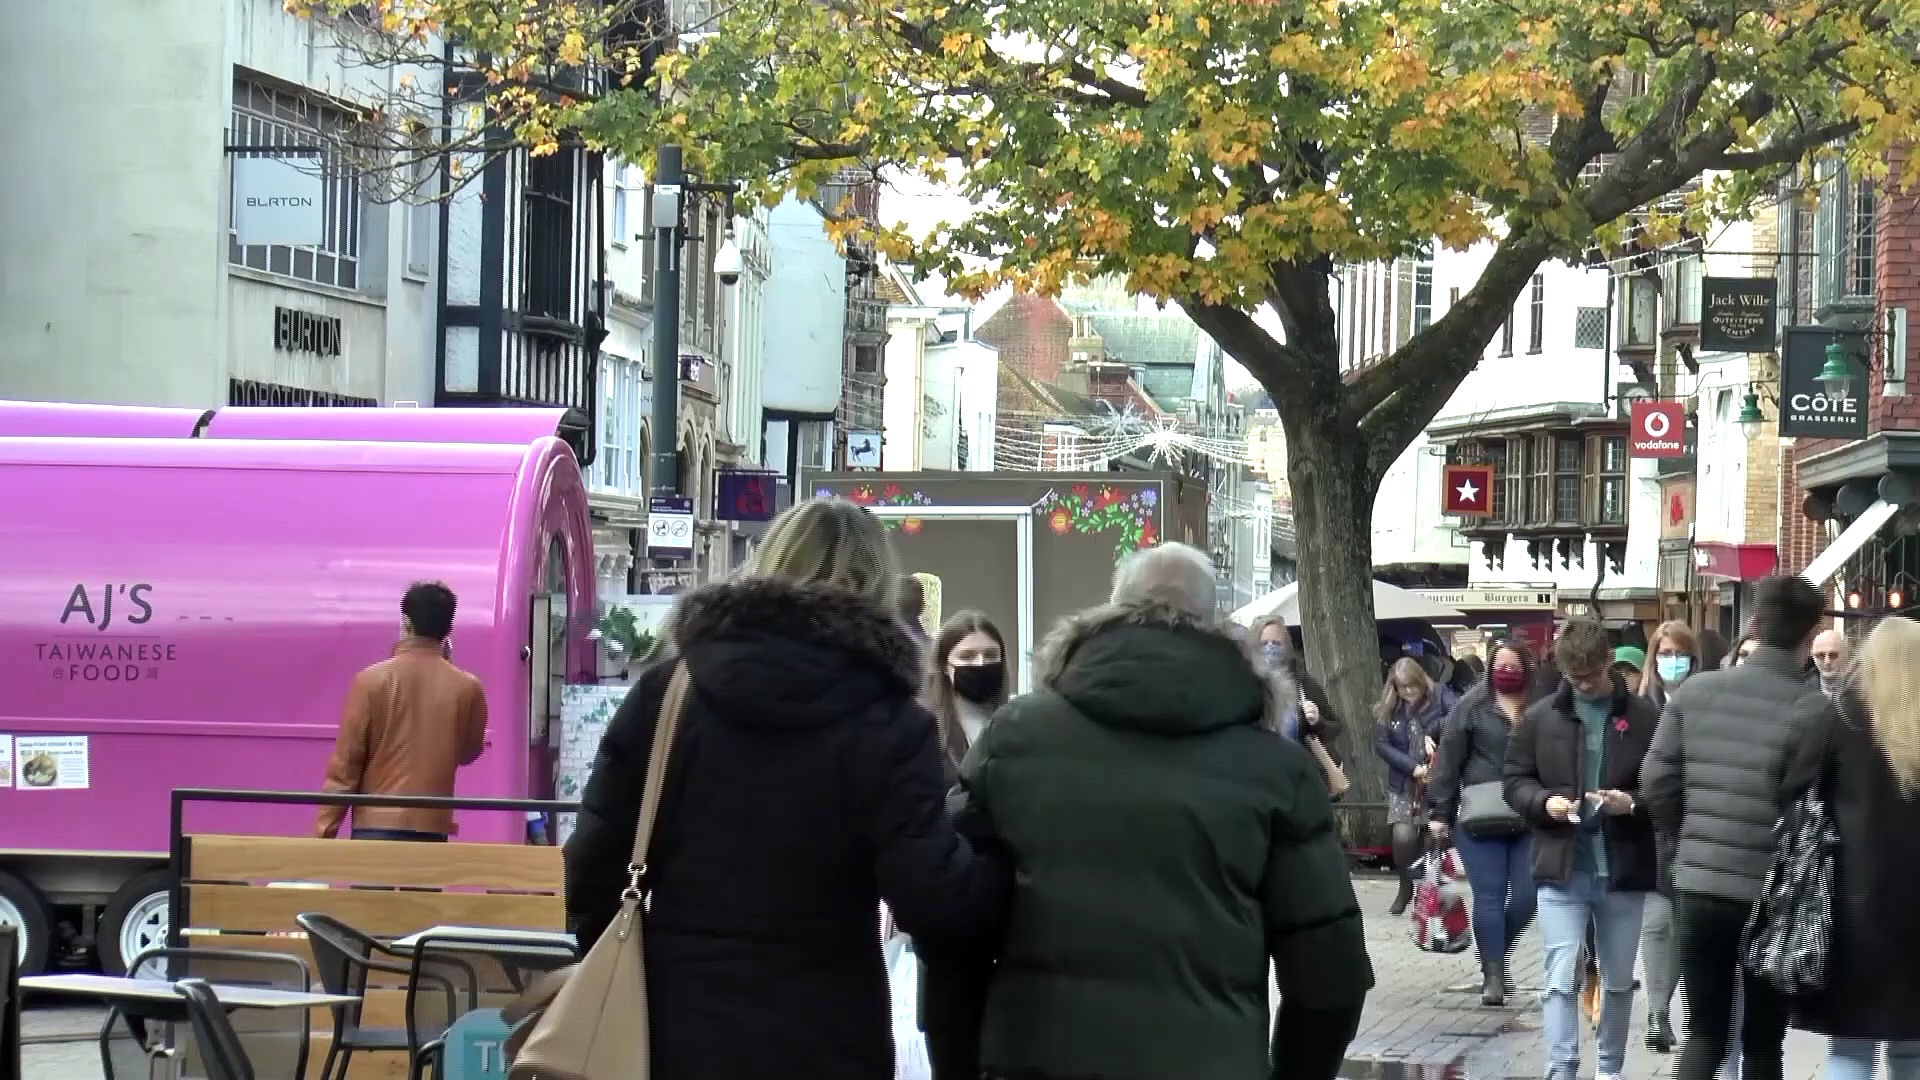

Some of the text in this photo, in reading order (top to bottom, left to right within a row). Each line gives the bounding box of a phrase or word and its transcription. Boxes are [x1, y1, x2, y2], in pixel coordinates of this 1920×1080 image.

[1708, 293, 1736, 309] Jack
[274, 305, 342, 356] BURTON
[1790, 392, 1858, 413] CÔTE
[1790, 414, 1857, 423] BRASSERIE
[1634, 440, 1680, 450] vodafone
[1423, 592, 1529, 604] ourmet Burgers
[59, 583, 153, 632] AJ'S
[34, 643, 177, 661] TAIWANESE
[69, 664, 140, 681] FOOD
